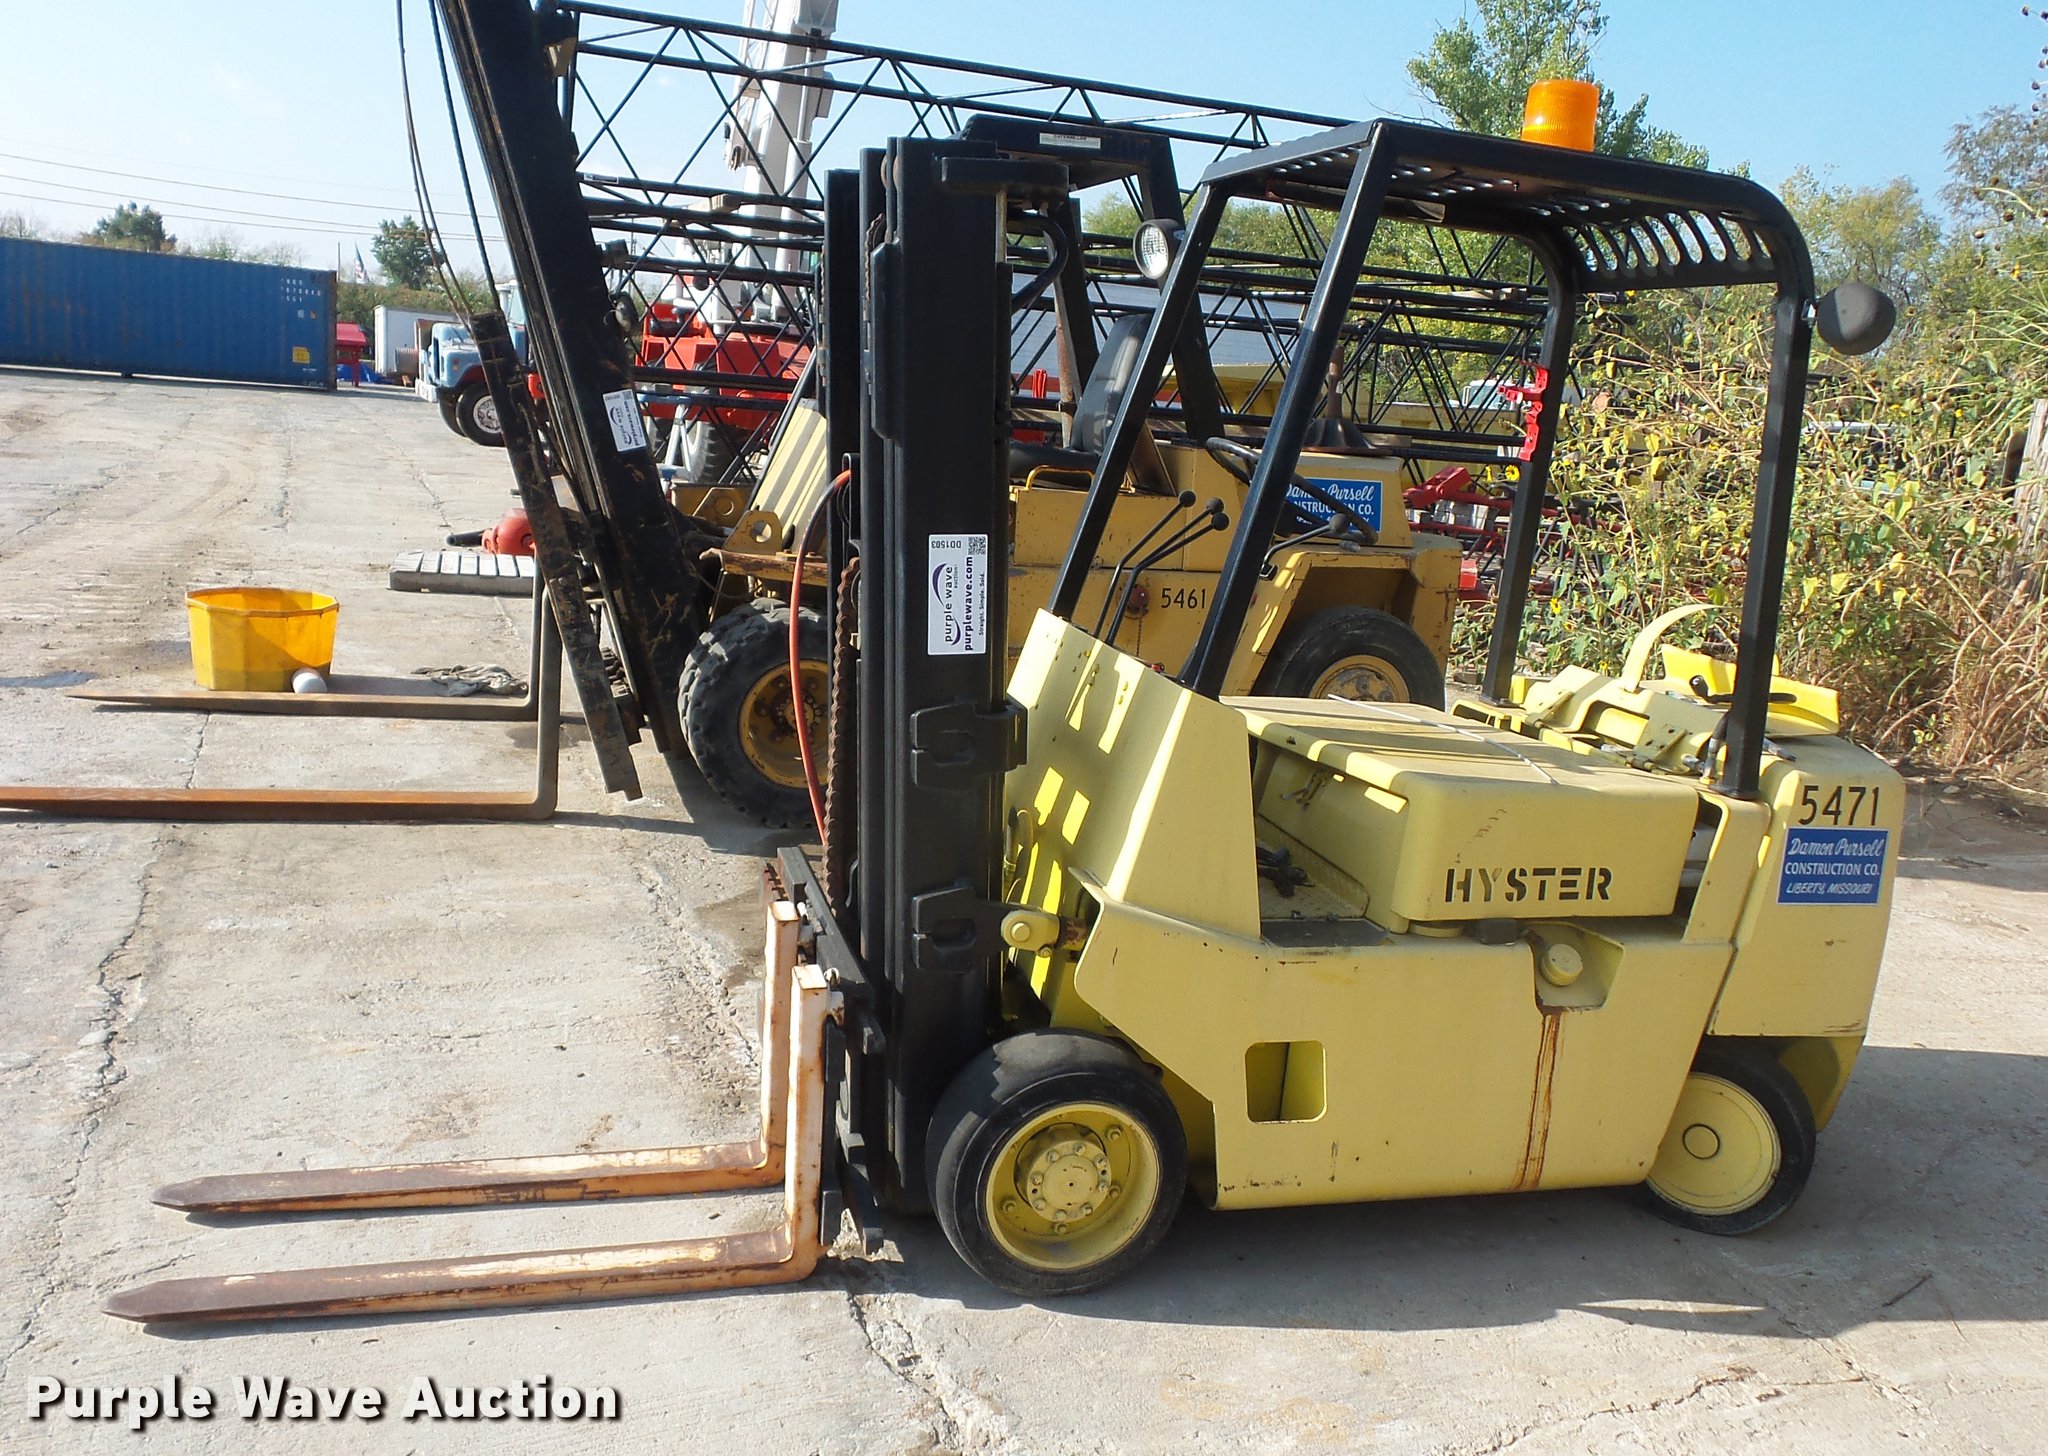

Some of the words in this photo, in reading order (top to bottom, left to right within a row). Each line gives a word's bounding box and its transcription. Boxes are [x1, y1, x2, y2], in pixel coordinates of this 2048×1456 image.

[1327, 483, 1375, 502] Pursell
[1358, 503, 1374, 516] CO.
[945, 566, 953, 600] wave
[963, 556, 974, 651] purplewave.com
[1161, 587, 1207, 609] 5461
[944, 604, 954, 642] purple
[1798, 785, 1880, 826] 5471
[1788, 838, 1834, 856] Damon
[1834, 838, 1885, 857] Pursell
[1785, 862, 1861, 876] CONSTRUCTION
[1863, 863, 1880, 876] CO.
[1444, 867, 1612, 903] HYSTER
[1786, 882, 1825, 895] LIBERTY,
[1827, 883, 1873, 895] MISSOURI
